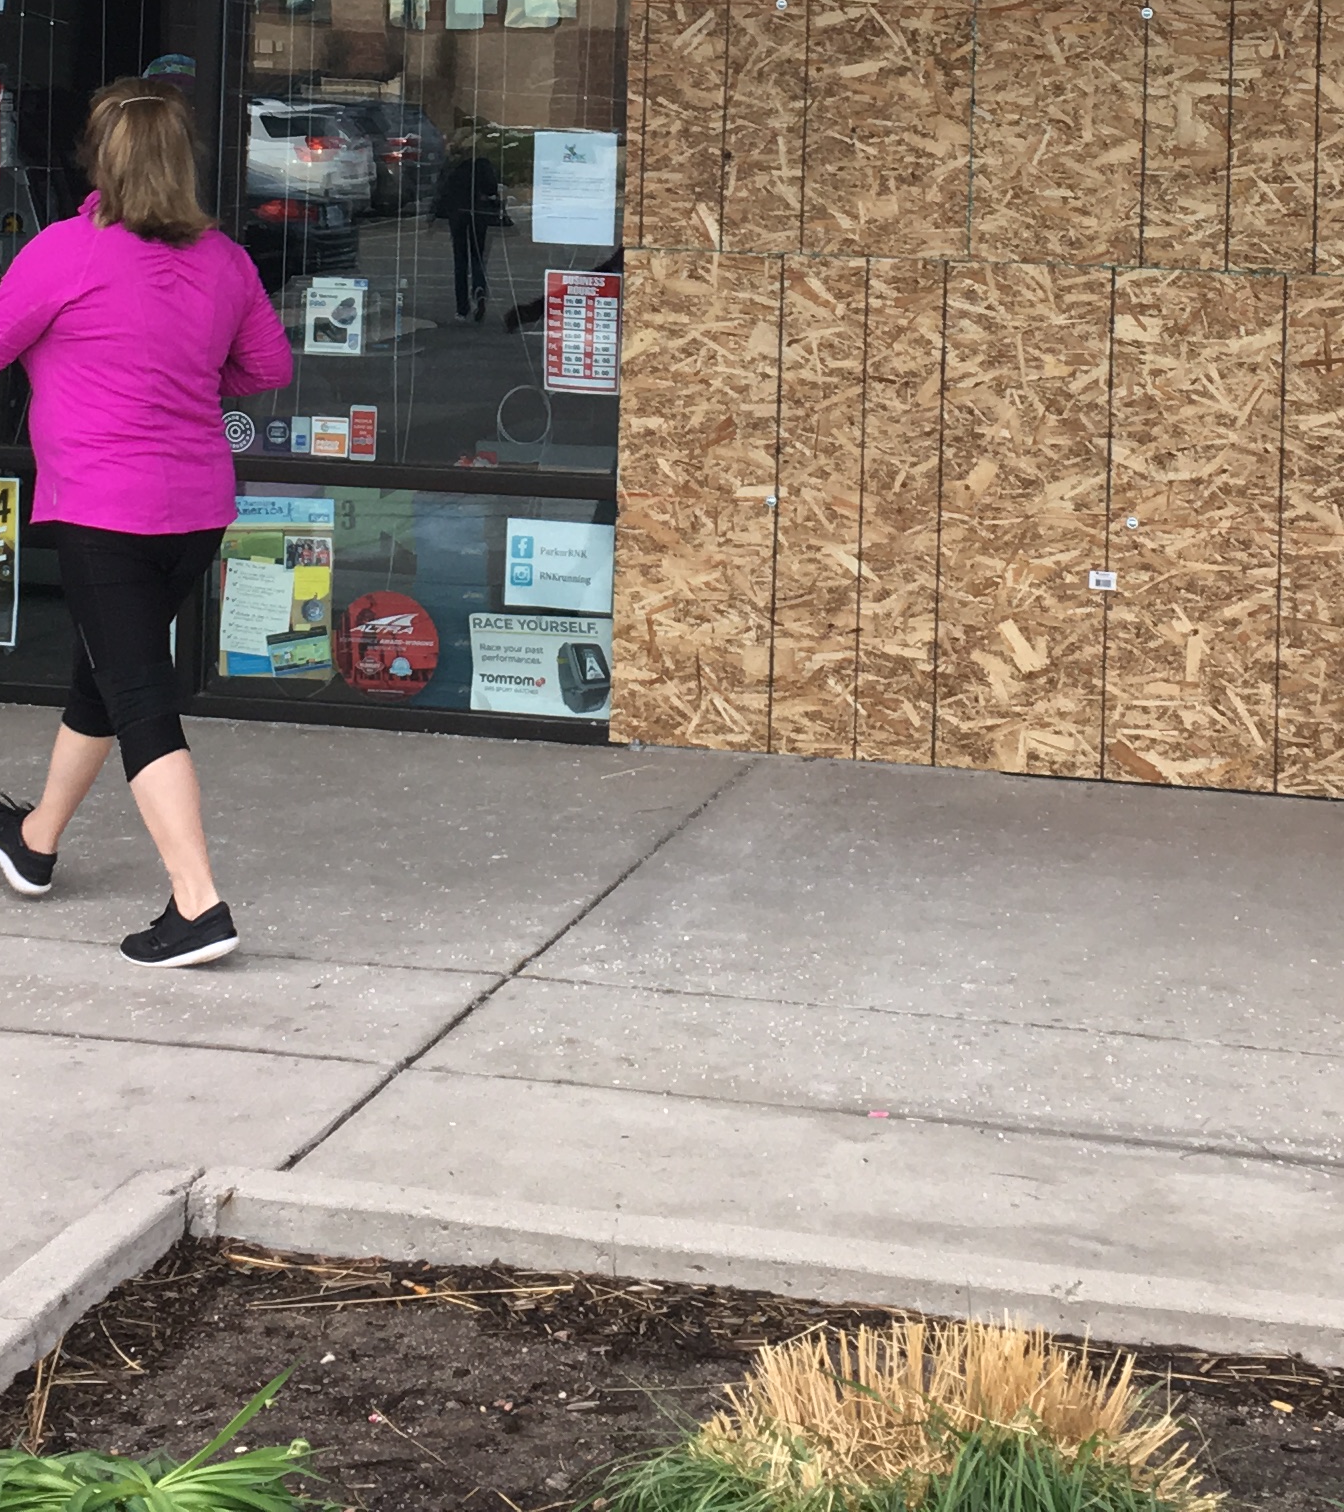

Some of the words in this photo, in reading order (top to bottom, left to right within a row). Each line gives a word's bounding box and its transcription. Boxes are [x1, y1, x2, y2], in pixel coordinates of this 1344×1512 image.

[562, 275, 605, 287] BUSINESS
[539, 571, 592, 586] RNKrunning
[349, 624, 414, 635] ALTRA
[472, 618, 514, 630] RACE
[517, 619, 599, 635] YOURSELF.
[479, 643, 502, 652] Race
[503, 645, 523, 654] your
[524, 646, 544, 654] past
